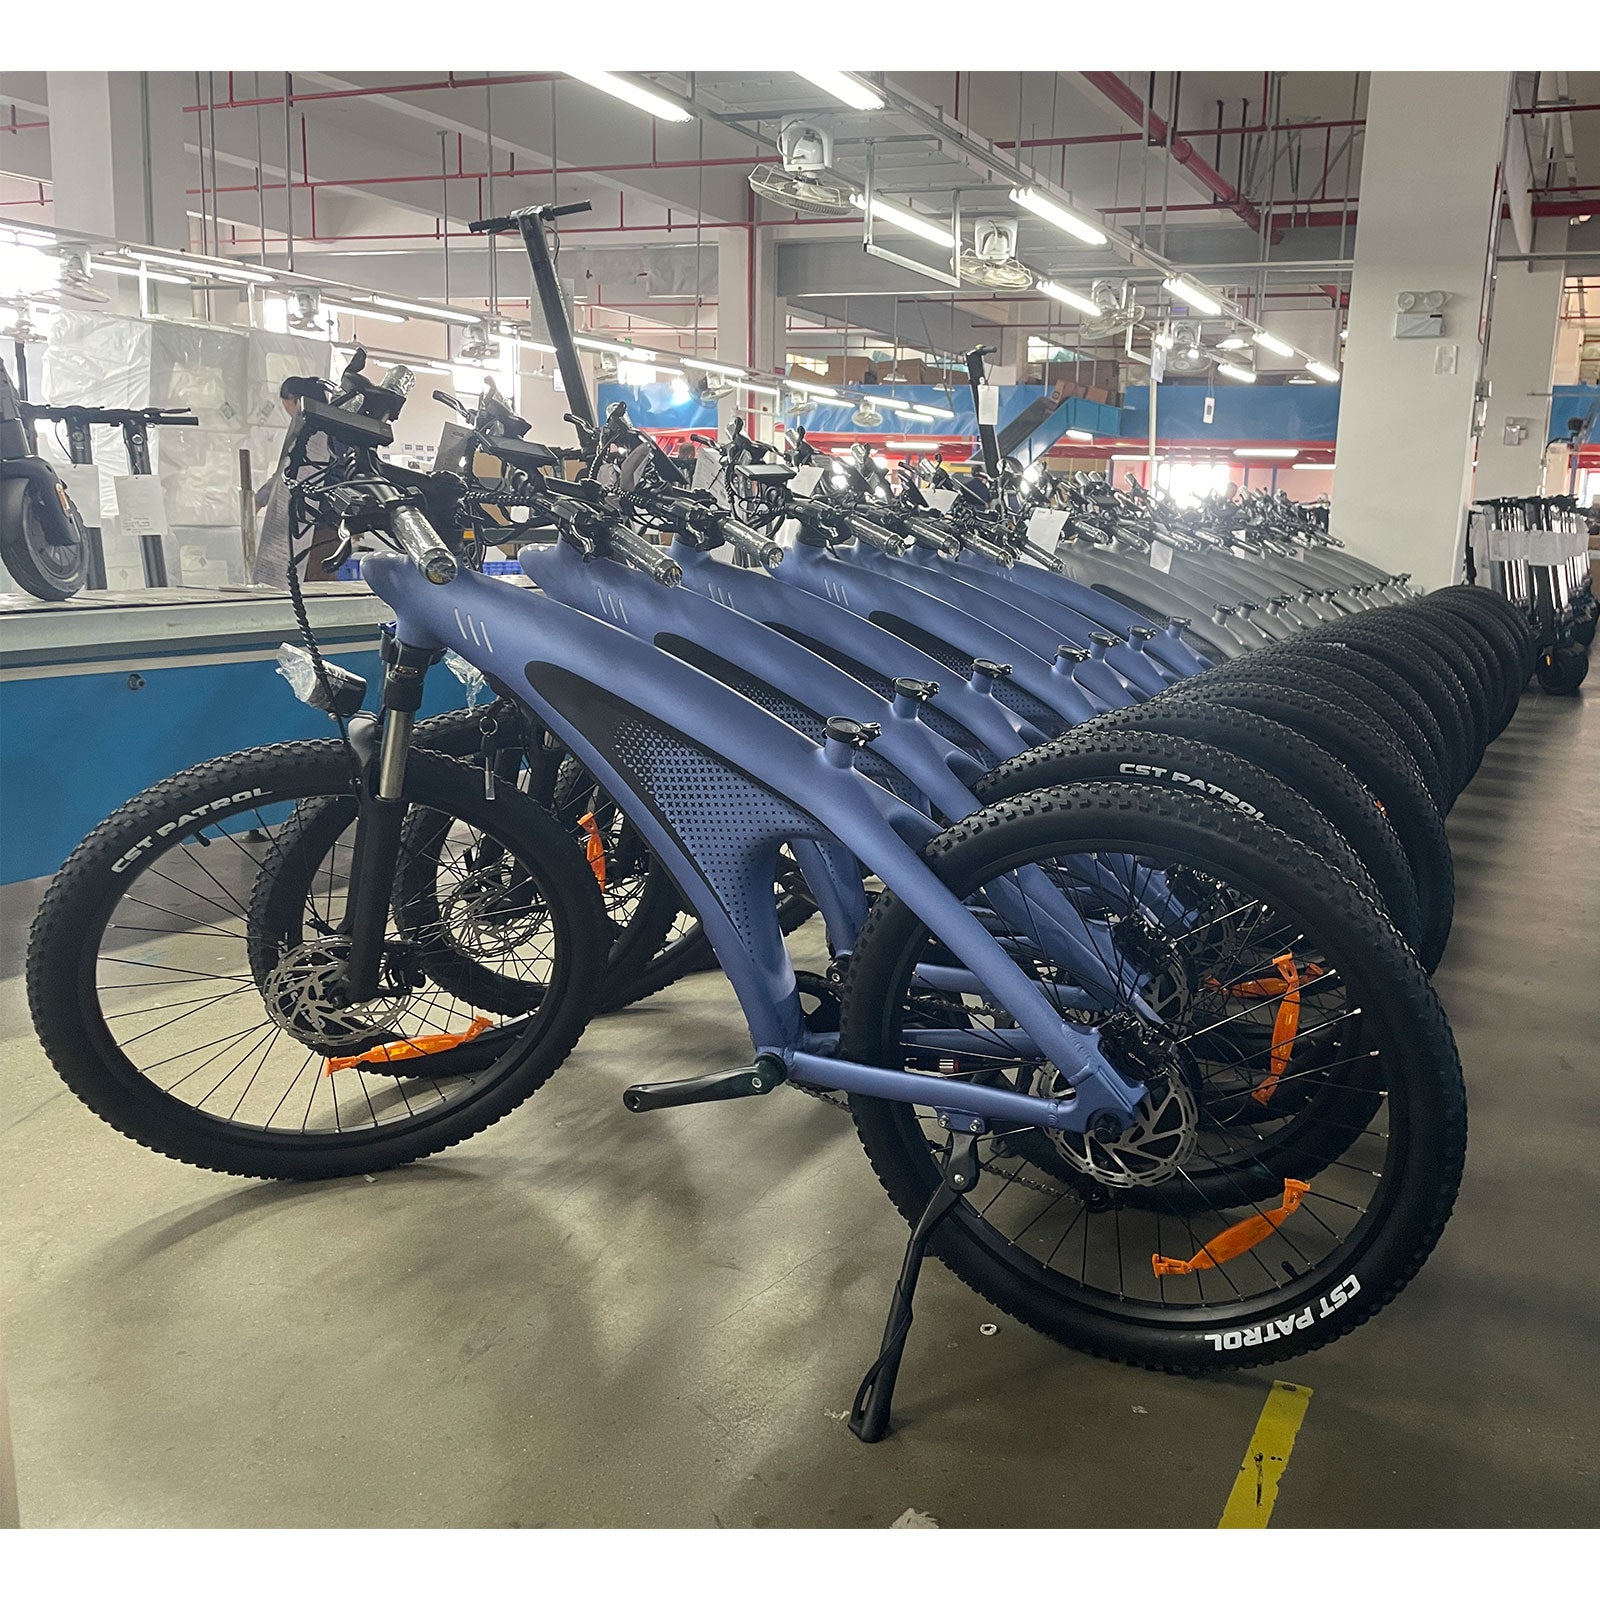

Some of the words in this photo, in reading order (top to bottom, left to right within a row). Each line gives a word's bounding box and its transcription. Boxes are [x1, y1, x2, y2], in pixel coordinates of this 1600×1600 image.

[1119, 763, 1168, 778] CST
[111, 835, 153, 873] CST
[156, 787, 273, 837] PATROL
[1319, 1274, 1361, 1319] CST
[1204, 1306, 1315, 1351] PATROL
